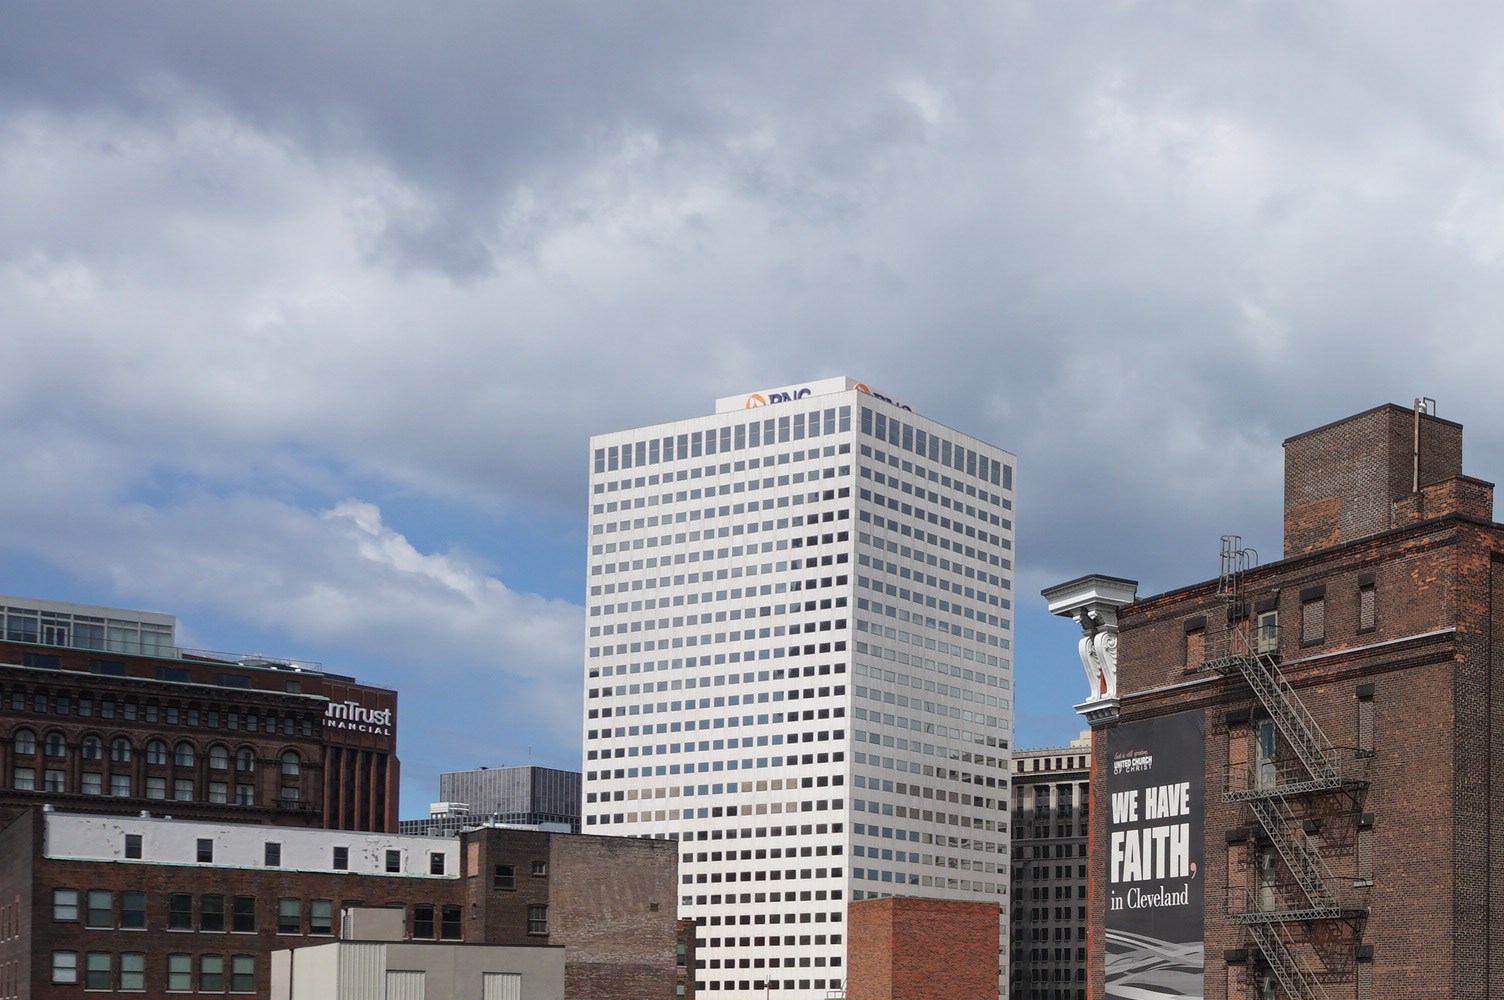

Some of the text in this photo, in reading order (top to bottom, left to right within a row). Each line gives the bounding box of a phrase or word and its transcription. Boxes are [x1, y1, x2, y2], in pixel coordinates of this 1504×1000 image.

[325, 700, 391, 726] mTrust
[322, 719, 391, 736] INANCIAL
[1114, 755, 1152, 768] UNITED CHURCH
[1114, 764, 1152, 775] OF CHRIST
[1112, 782, 1190, 824] WE HAVE
[1111, 823, 1197, 884] FAITH,
[1111, 883, 1189, 910] in Cleveland
